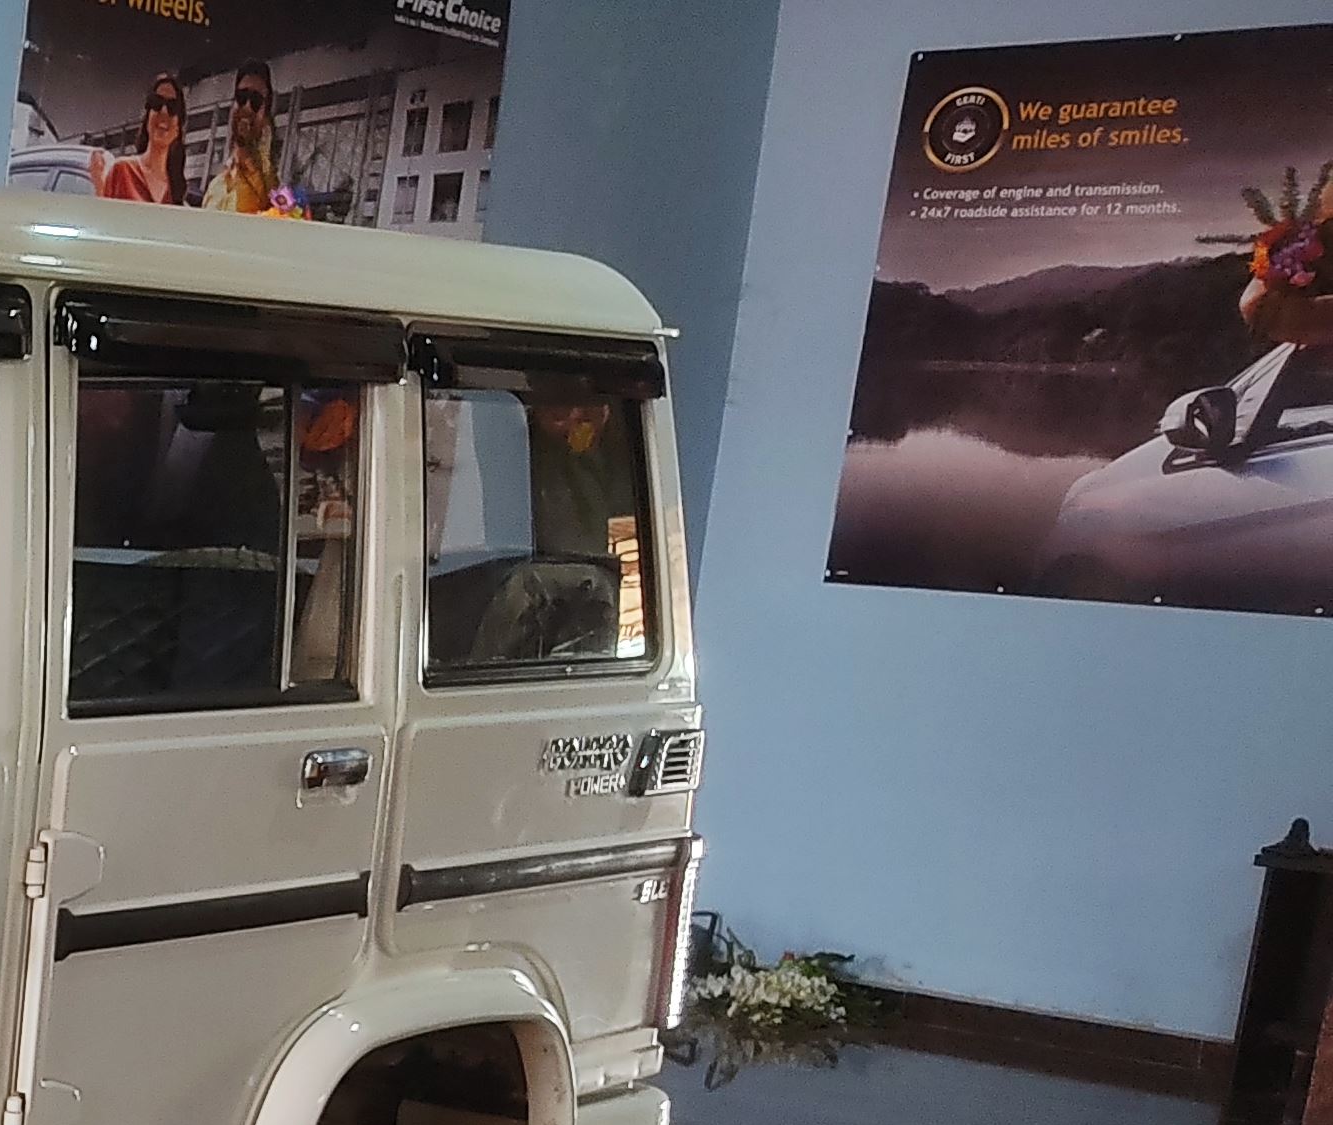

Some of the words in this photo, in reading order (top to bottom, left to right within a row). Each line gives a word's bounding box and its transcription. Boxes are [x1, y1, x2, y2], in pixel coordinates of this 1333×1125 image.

[1019, 100, 1053, 121] We
[1058, 97, 1178, 124] guarantee
[1012, 128, 1071, 150] miles
[1077, 126, 1106, 147] of
[1108, 123, 1190, 146] smiles.
[944, 151, 975, 165] FIRST
[923, 187, 981, 202] Coverage
[983, 185, 998, 199] of
[999, 185, 1043, 201] engine
[1045, 183, 1072, 198] and
[1075, 181, 1164, 197] transmission.
[920, 206, 952, 219] 24x7
[954, 204, 1008, 218] roadside
[1010, 203, 1077, 217] assistance
[1080, 203, 1101, 216] for
[1106, 202, 1122, 215] 12
[1125, 201, 1181, 215] months.
